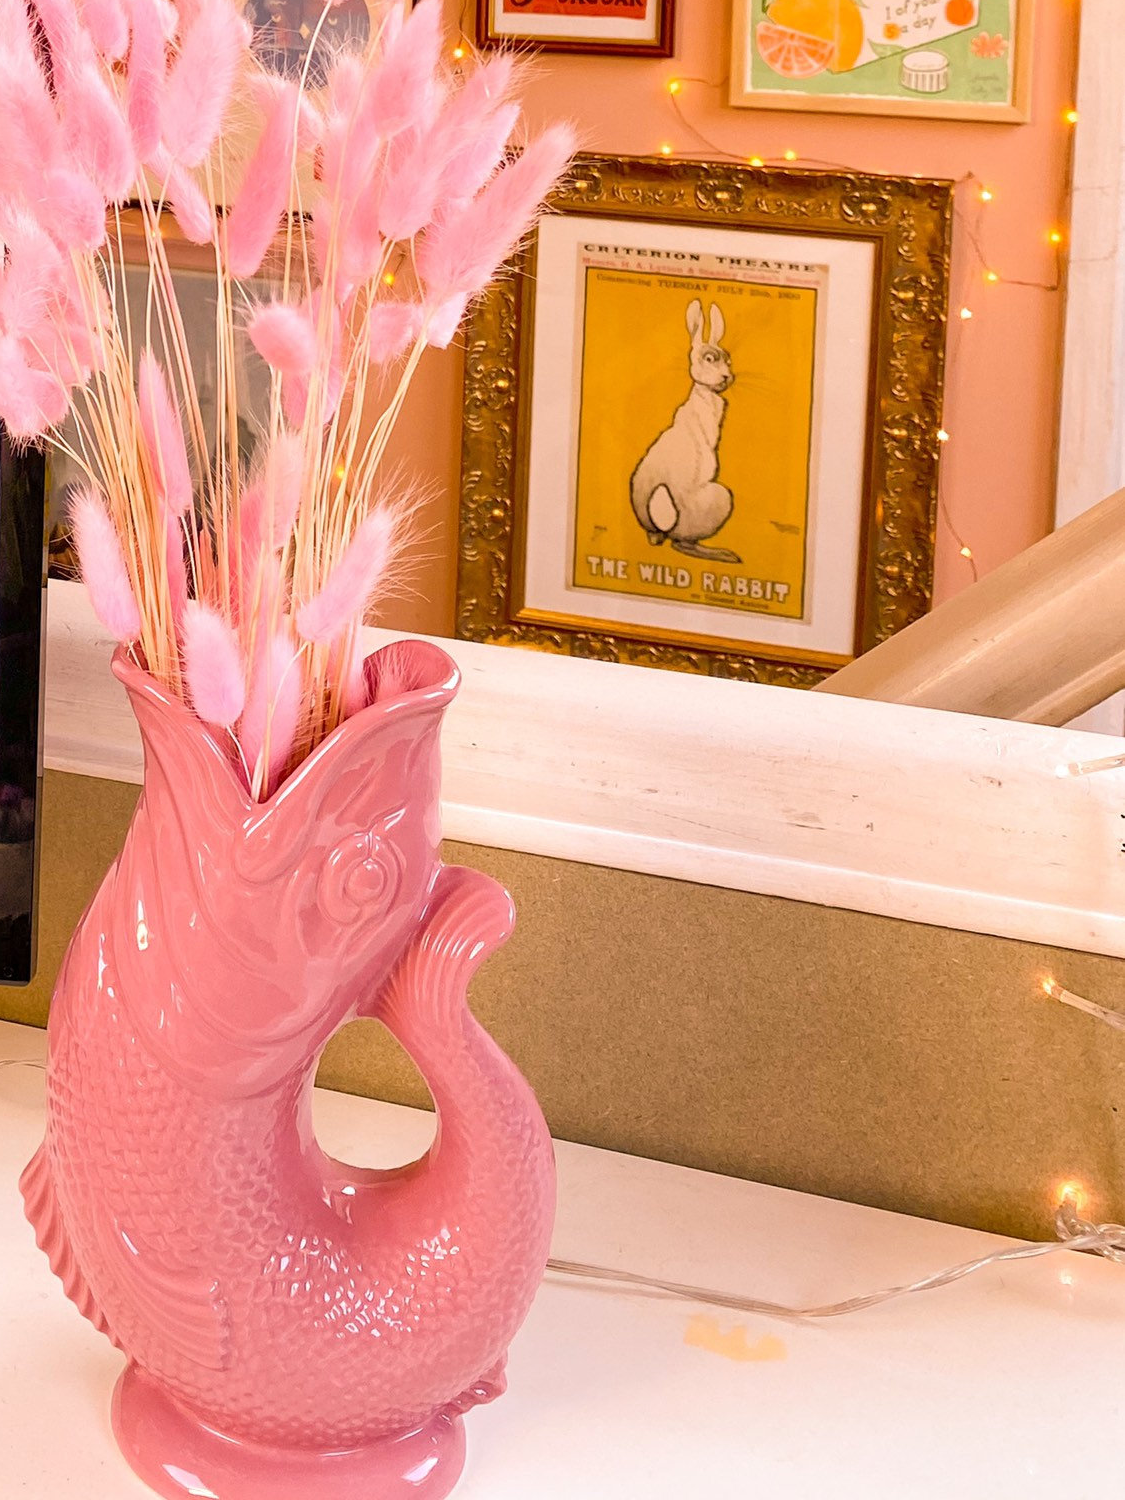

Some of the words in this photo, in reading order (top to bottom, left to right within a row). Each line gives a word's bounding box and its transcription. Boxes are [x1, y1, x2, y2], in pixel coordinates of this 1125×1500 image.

[583, 243, 701, 261] CRITERION
[715, 255, 817, 273] THEATRE
[586, 555, 628, 580] THE
[638, 562, 692, 589] WILD
[701, 571, 790, 603] RABBIT
